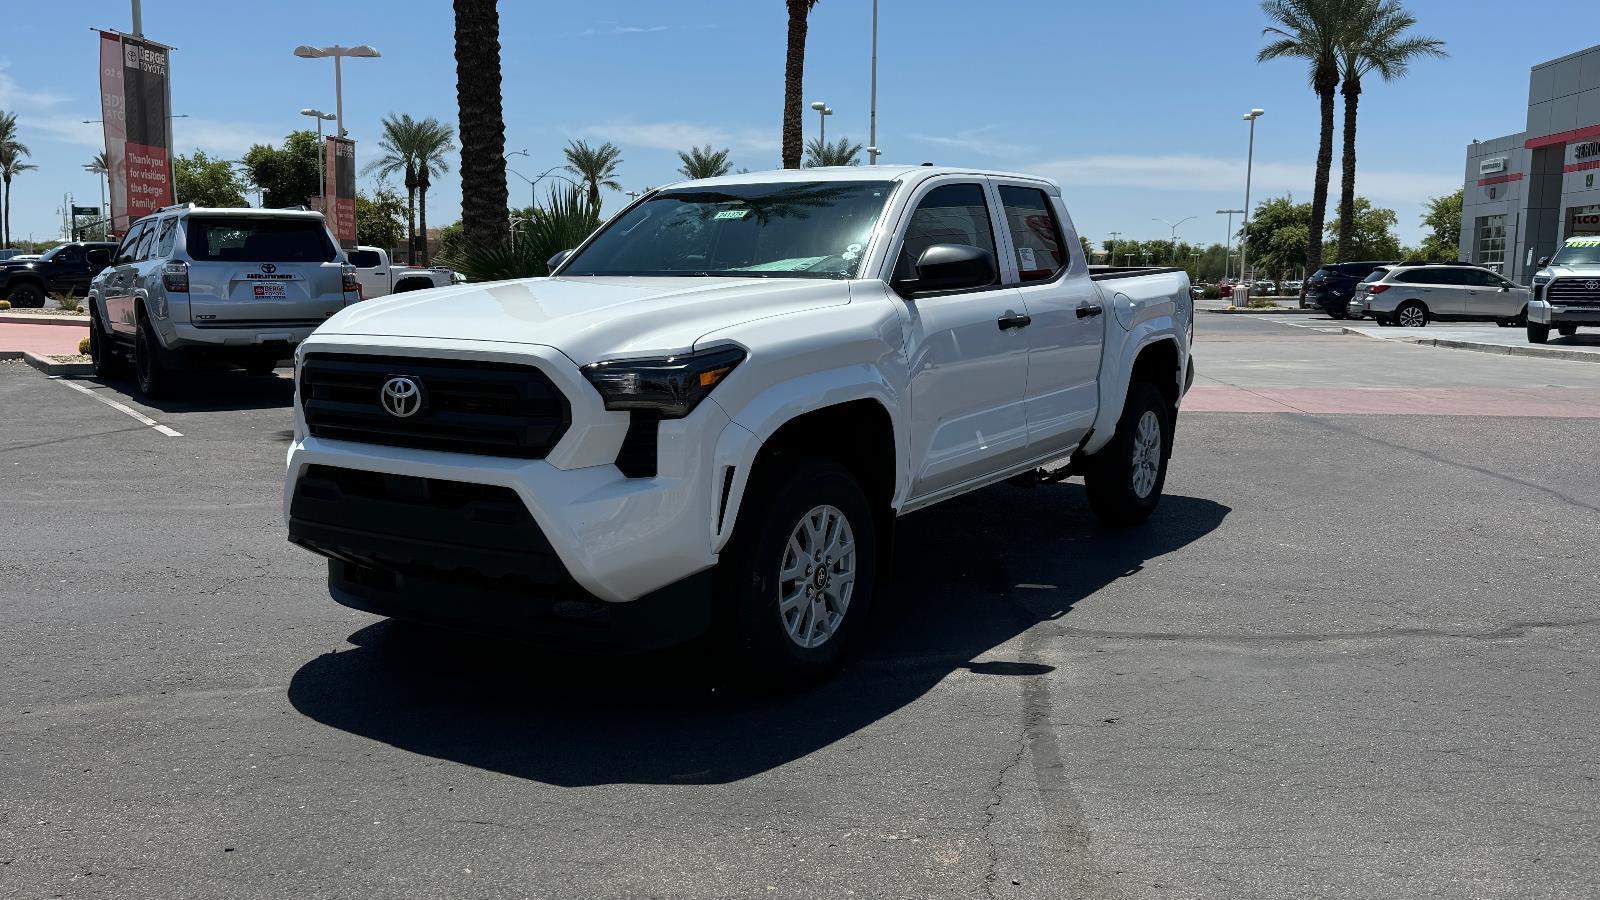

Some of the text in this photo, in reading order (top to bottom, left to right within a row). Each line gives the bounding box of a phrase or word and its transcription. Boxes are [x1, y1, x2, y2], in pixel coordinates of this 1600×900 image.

[139, 45, 165, 66] BERGE
[140, 61, 165, 76] TOYOTA
[129, 152, 164, 168] Thank you
[130, 167, 166, 184] for visiting
[131, 182, 164, 197] the Berge
[131, 197, 156, 210] Family!
